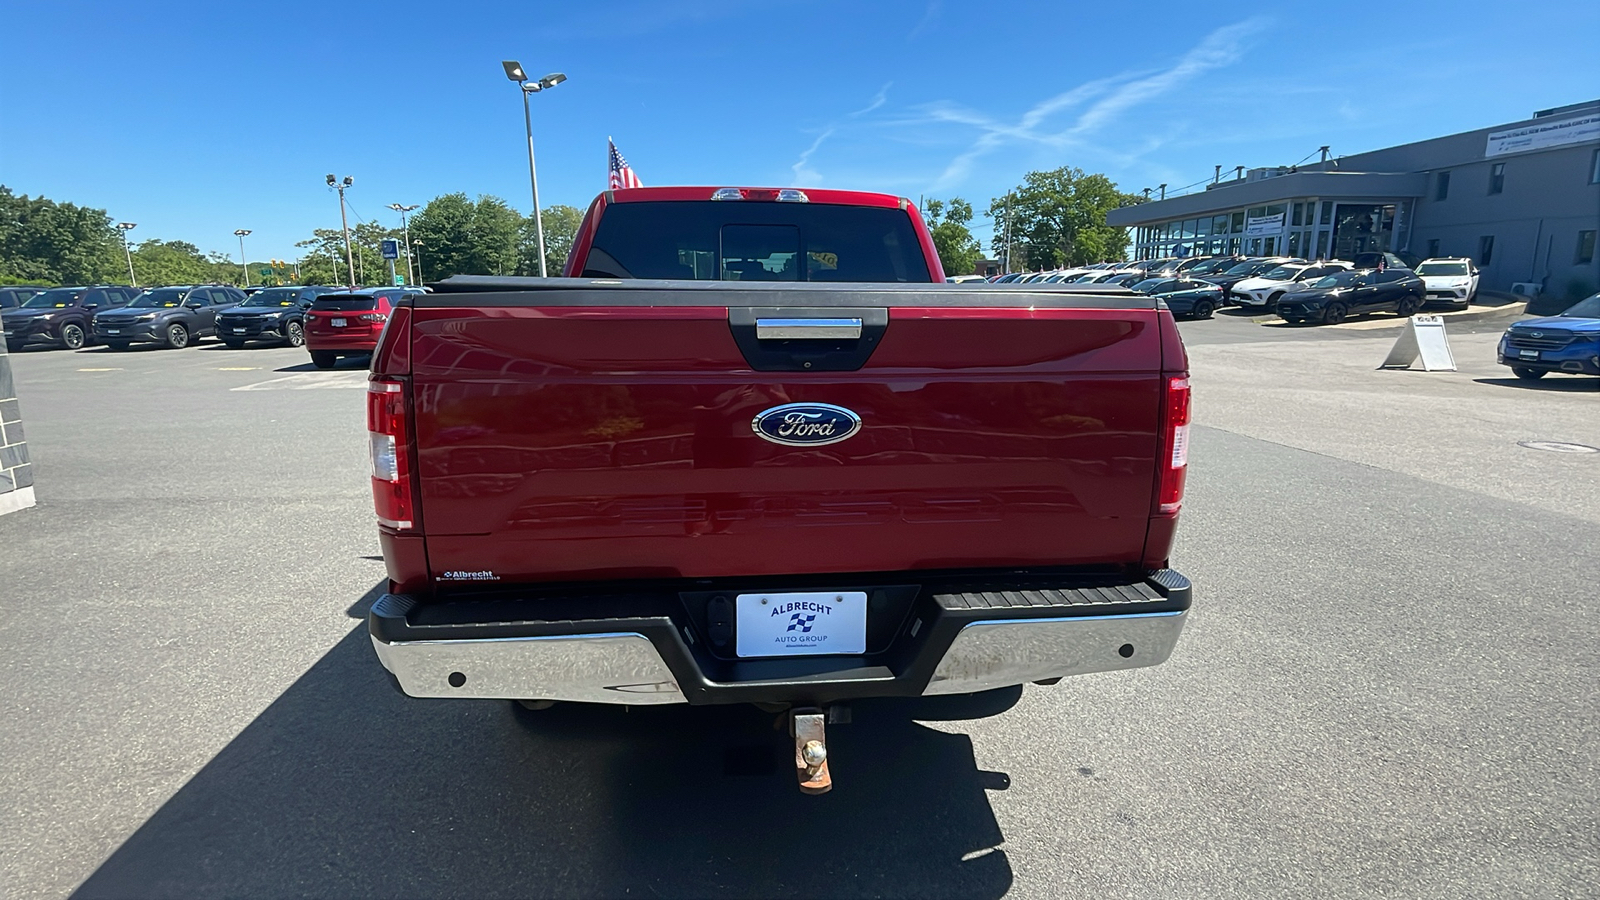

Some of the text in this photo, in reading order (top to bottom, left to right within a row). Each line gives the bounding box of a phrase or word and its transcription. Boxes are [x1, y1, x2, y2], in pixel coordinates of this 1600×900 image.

[778, 412, 837, 437] Ford
[453, 570, 493, 578] Albrecht
[770, 602, 832, 617] ALBRECHT
